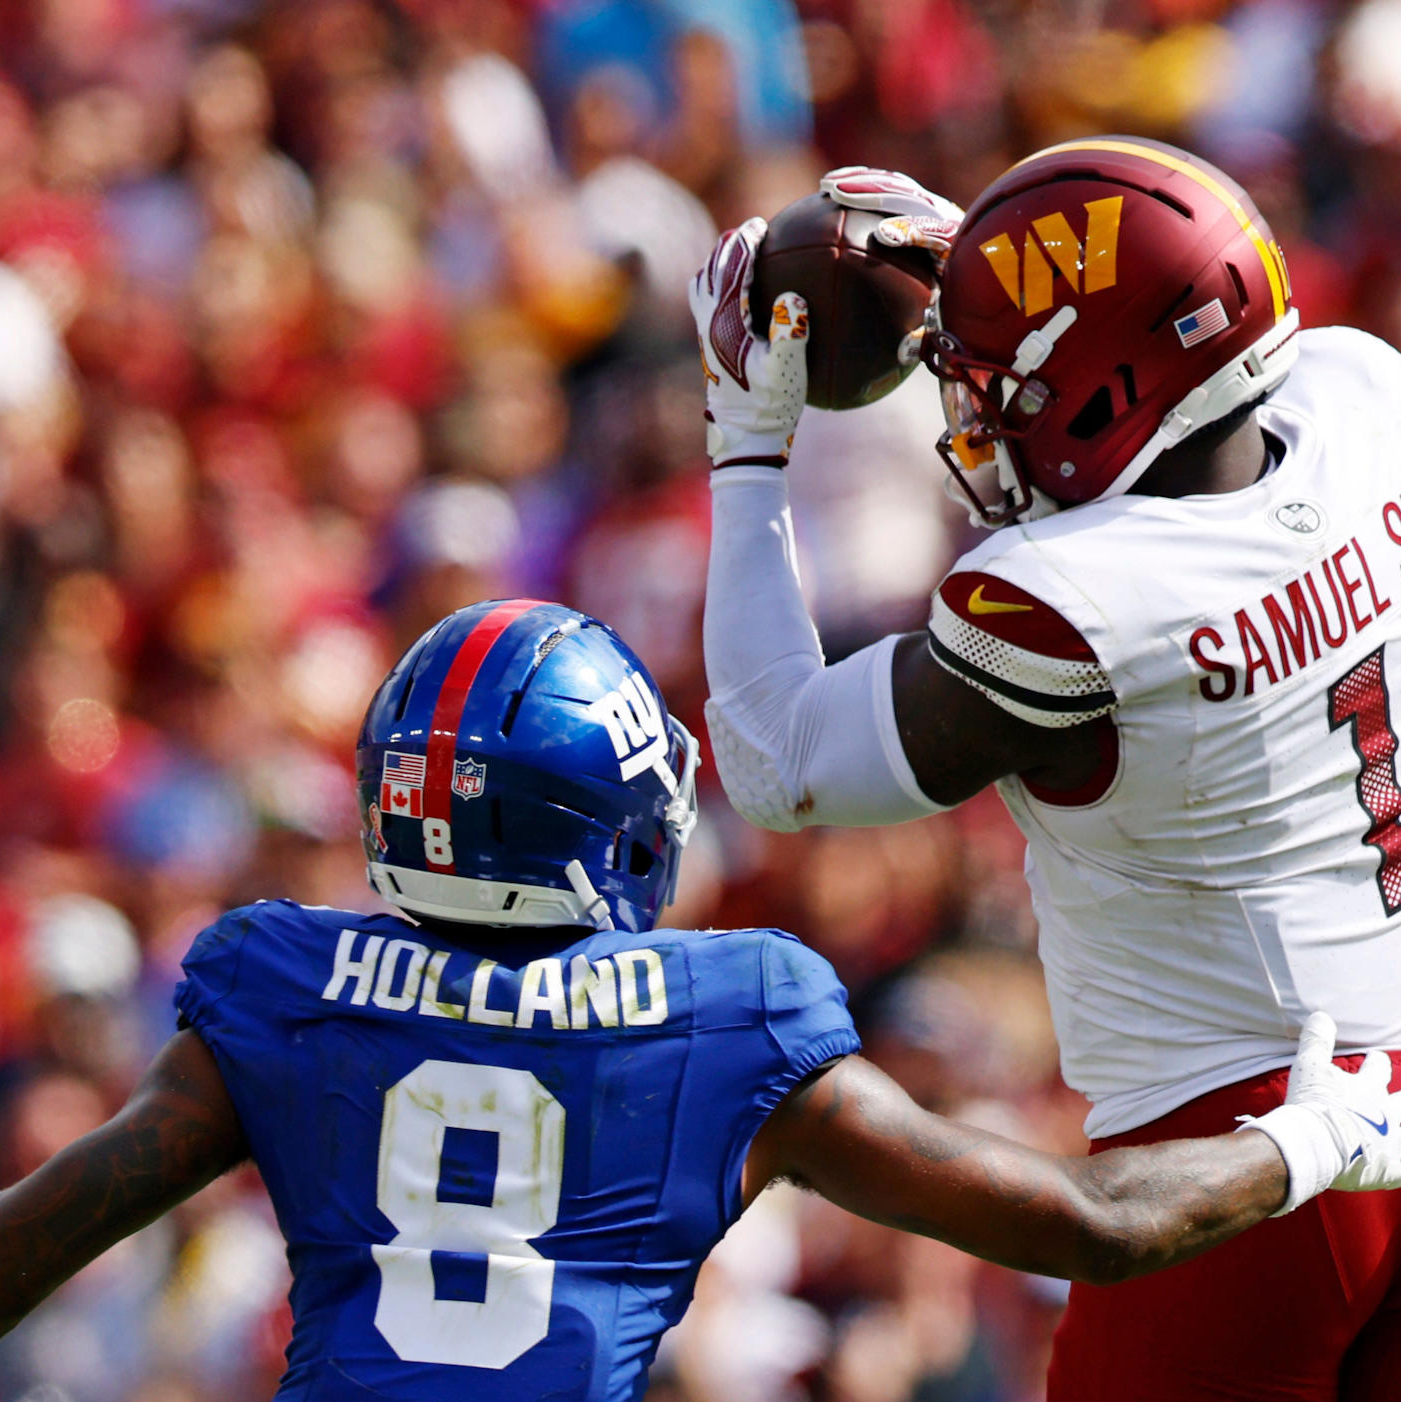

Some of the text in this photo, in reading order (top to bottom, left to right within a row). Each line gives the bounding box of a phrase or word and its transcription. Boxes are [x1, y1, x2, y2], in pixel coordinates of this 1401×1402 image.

[1189, 537, 1392, 703] SAMUEL
[456, 774, 480, 794] NFL
[423, 817, 454, 866] 8
[322, 929, 667, 1030] HOLLAND
[371, 1059, 566, 1370] 8
